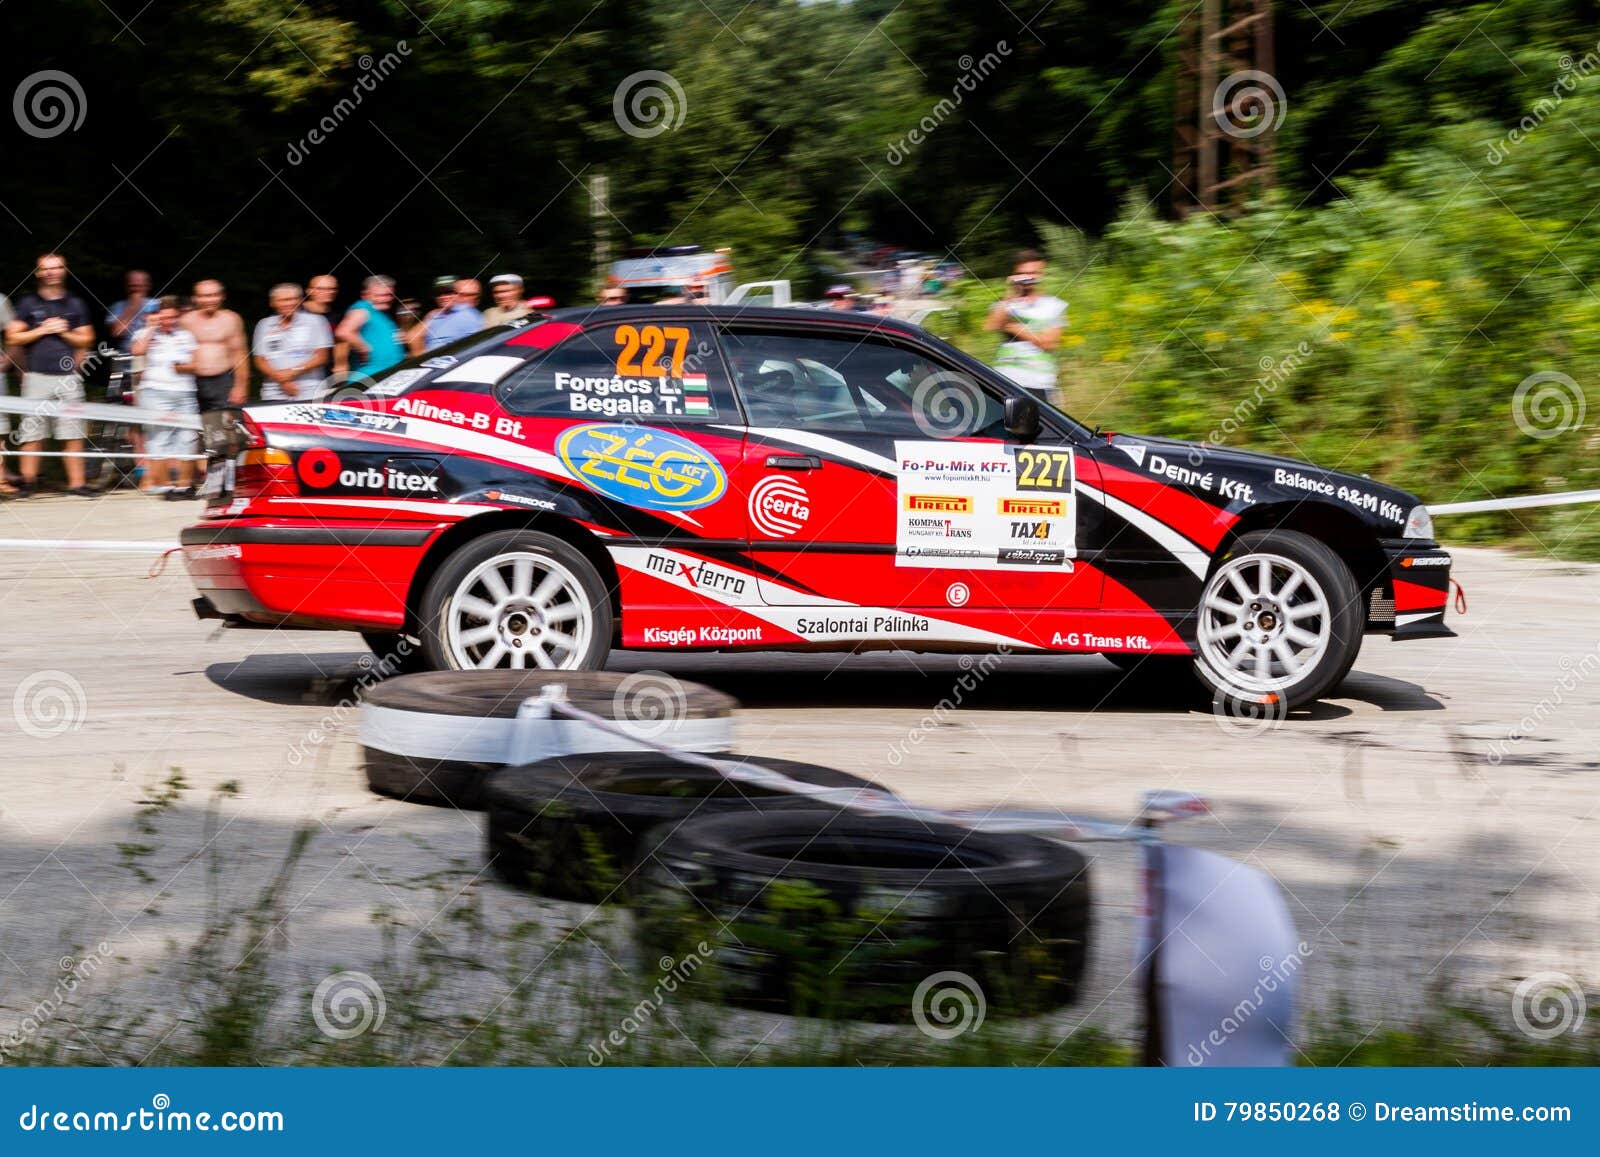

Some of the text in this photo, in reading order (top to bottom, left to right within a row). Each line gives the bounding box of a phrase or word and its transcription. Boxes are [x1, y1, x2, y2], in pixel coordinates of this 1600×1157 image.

[615, 324, 691, 378] 227
[555, 372, 682, 396] Forgács L.
[569, 393, 683, 417] Begala T.
[391, 397, 528, 440] Alinea-B Bt.
[680, 463, 710, 481] KFT
[902, 460, 1011, 473] Fo-Pu-Mix KFT.
[1017, 451, 1069, 488] 227
[1148, 454, 1257, 505] Denré Kft.
[761, 493, 811, 521] certa
[909, 495, 968, 512] PIRELLI
[1003, 499, 1061, 515] PIRELLI
[1274, 467, 1406, 525] Balance A&M Kft.
[645, 553, 746, 596] maxferro
[643, 625, 763, 645] Kisgép Központ
[796, 616, 930, 635] Szalontai Pálinka
[1051, 631, 1152, 650] A-G Trans Kft.
